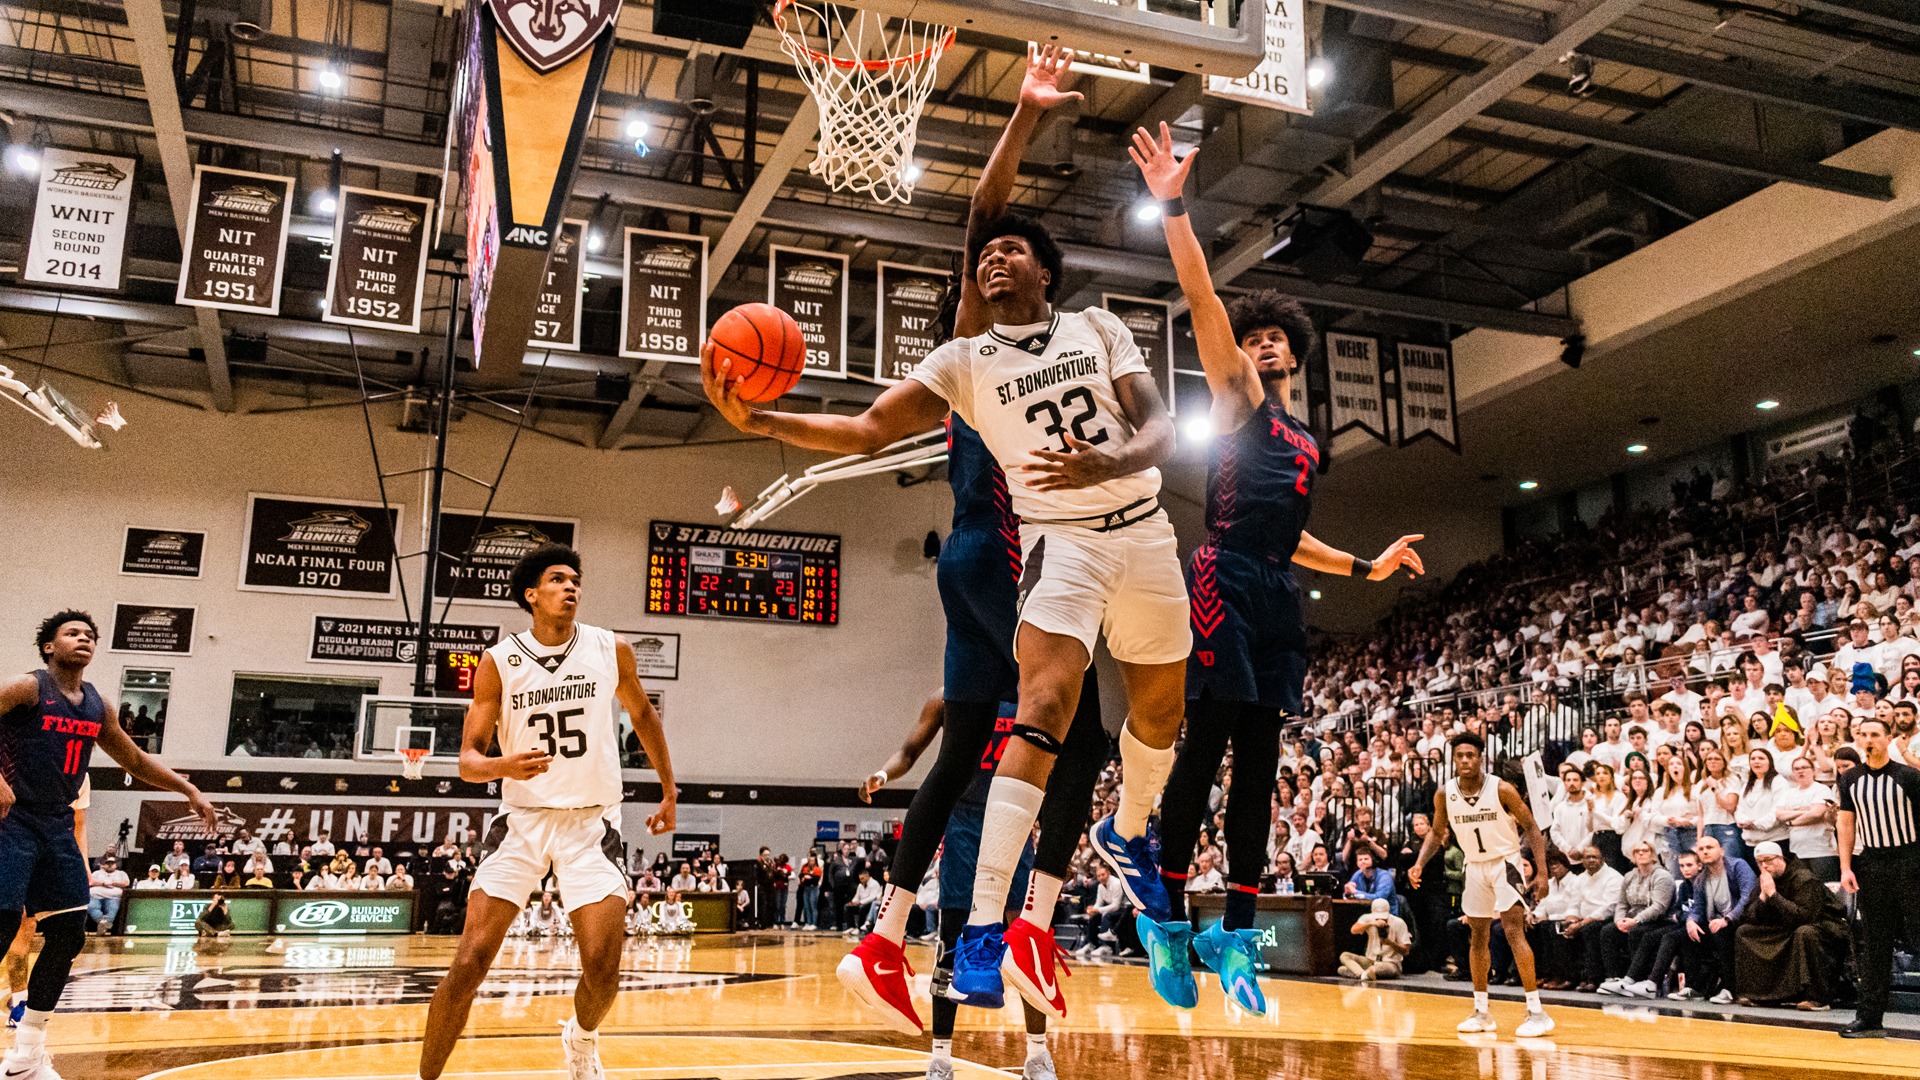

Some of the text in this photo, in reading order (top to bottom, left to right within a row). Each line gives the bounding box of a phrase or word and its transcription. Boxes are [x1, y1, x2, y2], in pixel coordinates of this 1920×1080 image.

[54, 175, 117, 191] BONNIES
[47, 186, 123, 201] WOMEN'S BASKETBALL
[213, 199, 271, 215] BONNIES
[51, 205, 115, 225] WNIT
[208, 210, 271, 223] MEN'S BASKETBALL
[358, 218, 411, 232] BONNIES
[52, 229, 105, 244] SECOND
[218, 228, 256, 247] NIT
[353, 228, 412, 243] MEN'S BASKETBALL
[505, 228, 548, 245] ANC
[54, 241, 101, 255] ROUND
[203, 250, 265, 267] QUARTER
[362, 247, 398, 265] NIT
[46, 259, 102, 280] 2014
[208, 263, 257, 277] FINALS
[644, 258, 690, 270] BONNIES
[359, 269, 397, 283] THIRD
[787, 274, 832, 286] BONNIES
[203, 280, 255, 301] 1951
[356, 281, 396, 295] PLACE
[650, 284, 681, 300] NIT
[894, 291, 940, 302] BONNIES
[347, 297, 401, 319] 1952
[648, 306, 682, 317] THIRD
[794, 301, 823, 316] NIT
[535, 321, 561, 338] 57
[647, 316, 682, 329] PLACE
[901, 316, 929, 331] NIT
[1124, 320, 1159, 332] ONNIES
[640, 332, 688, 351] 1958
[804, 335, 825, 344] UND
[895, 335, 934, 348] FOURTH
[805, 350, 830, 366] 59
[899, 346, 930, 358] PLACE
[893, 361, 920, 377] 19
[995, 356, 1098, 405] ST. BONAVENTURE
[1025, 386, 1109, 453] 32
[1294, 454, 1309, 496] 2
[290, 532, 358, 543] BONNIES
[309, 526, 361, 535] BONAVENTURE
[287, 543, 357, 554] MEN'S BASKETBALL
[255, 552, 385, 572] NCAA FINAL FOUR
[651, 554, 665, 565] 01
[735, 551, 768, 568] 5:34
[450, 566, 474, 578] NT
[650, 566, 664, 576] 04
[694, 565, 723, 575] BONNIES
[772, 571, 794, 580] GUEST
[803, 566, 816, 576] 02
[298, 571, 341, 587] 1970
[650, 577, 663, 588] 05
[700, 575, 720, 591] 22
[745, 579, 750, 591] 1
[806, 578, 816, 587] 11
[483, 583, 512, 598] 197
[650, 589, 663, 600] 32
[775, 580, 795, 596] 23
[806, 589, 815, 599] 15
[649, 601, 662, 612] 35
[699, 598, 708, 611] 5
[725, 599, 738, 612] 11
[744, 601, 750, 612] 1
[759, 601, 768, 614] 5
[771, 603, 778, 613] 3
[788, 603, 797, 616] 6
[803, 600, 815, 610] 22
[802, 611, 815, 621] 24
[338, 623, 477, 639] 2021 MEN'S BAKTBALL
[318, 635, 394, 647] REGULAR SEASON
[428, 641, 486, 651] TOURNAMENT
[317, 643, 394, 658] CHAMPIONS
[449, 653, 479, 667] 5:34
[509, 656, 520, 666] 31
[511, 682, 597, 710] ST. BONAVENTURE
[528, 708, 587, 759] 35
[64, 739, 83, 775] 11
[1462, 812, 1497, 823] BONAVENTURE
[1474, 827, 1487, 853] 1
[351, 906, 400, 915] BUILDING
[350, 914, 393, 923] SERVICES
[1257, 925, 1278, 950] psi
